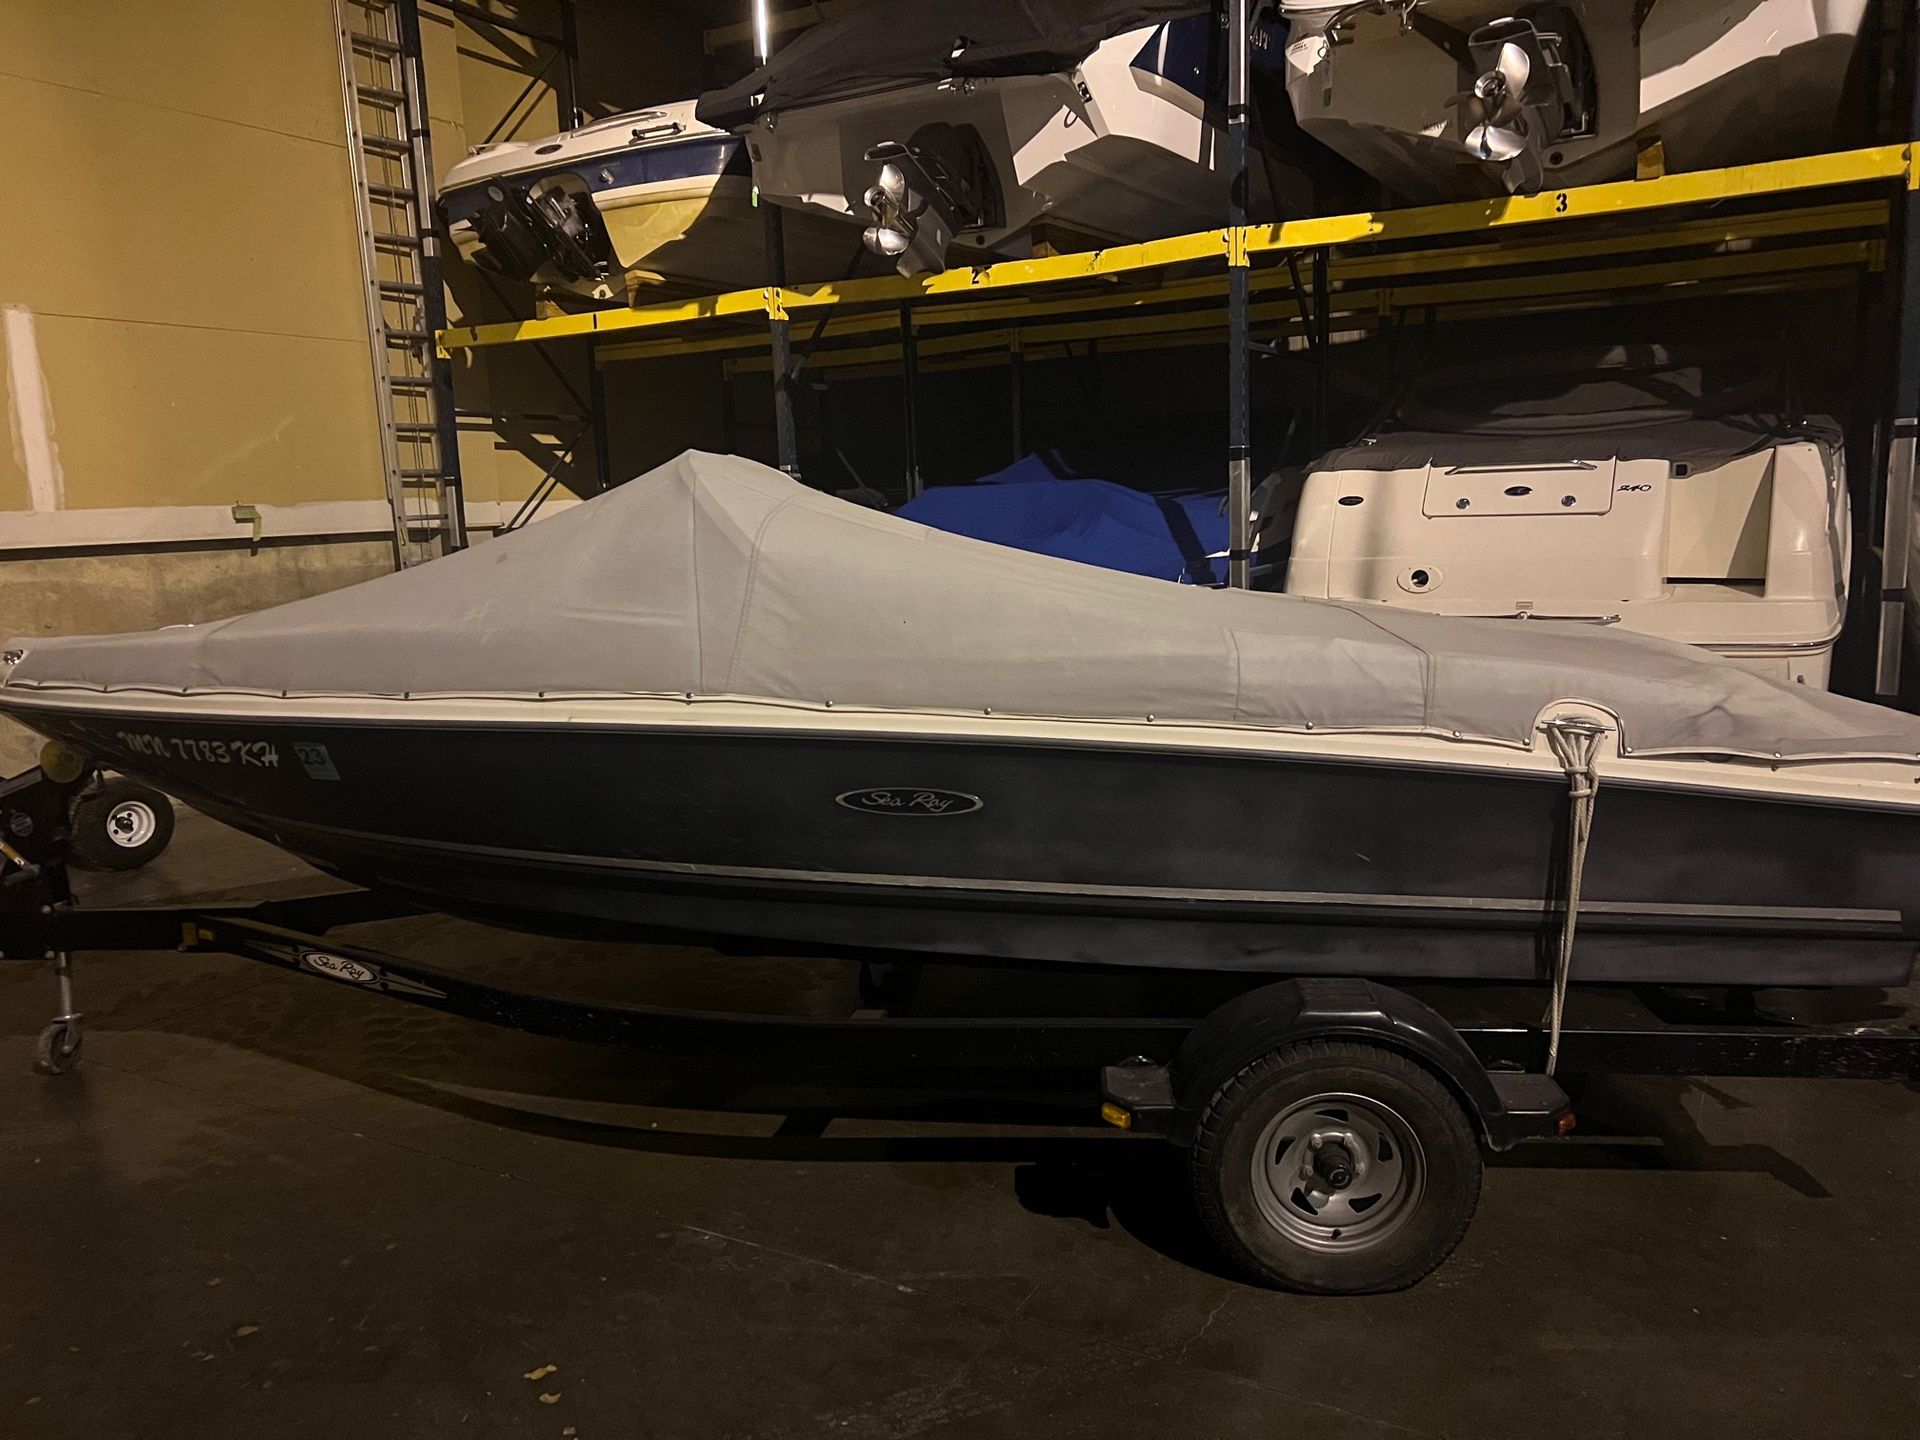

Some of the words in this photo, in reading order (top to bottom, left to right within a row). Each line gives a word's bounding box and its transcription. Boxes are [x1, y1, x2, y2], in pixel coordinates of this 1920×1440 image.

[1556, 193, 1568, 212] 3
[971, 268, 980, 285] 2
[170, 738, 231, 764] 7783
[299, 748, 325, 765] 23
[862, 791, 904, 806] Sea
[908, 791, 954, 812] Ray
[314, 955, 338, 970] Sea
[339, 960, 365, 980] Ray
